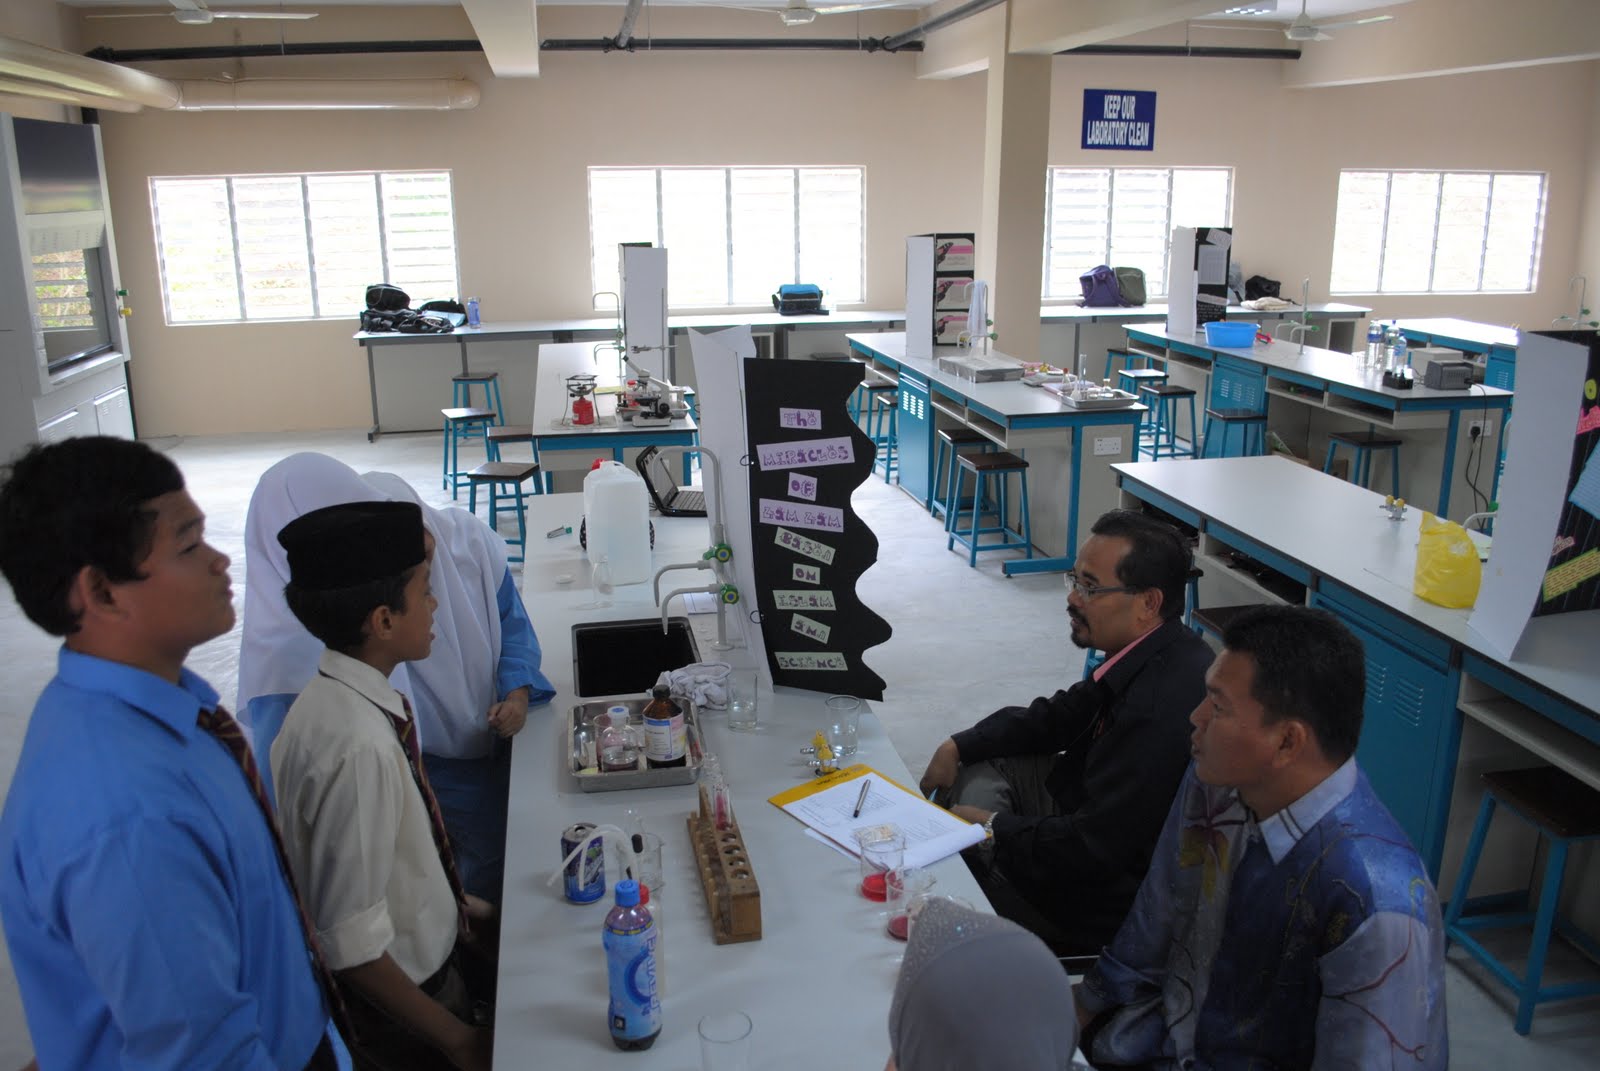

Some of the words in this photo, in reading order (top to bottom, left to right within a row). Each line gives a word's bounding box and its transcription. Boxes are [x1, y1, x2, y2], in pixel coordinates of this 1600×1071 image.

[1104, 95, 1121, 119] KEEP
[1121, 95, 1136, 120] OUR
[1087, 120, 1129, 146] LABORATORY
[1128, 121, 1150, 146] CLEAN
[791, 479, 815, 497] OF
